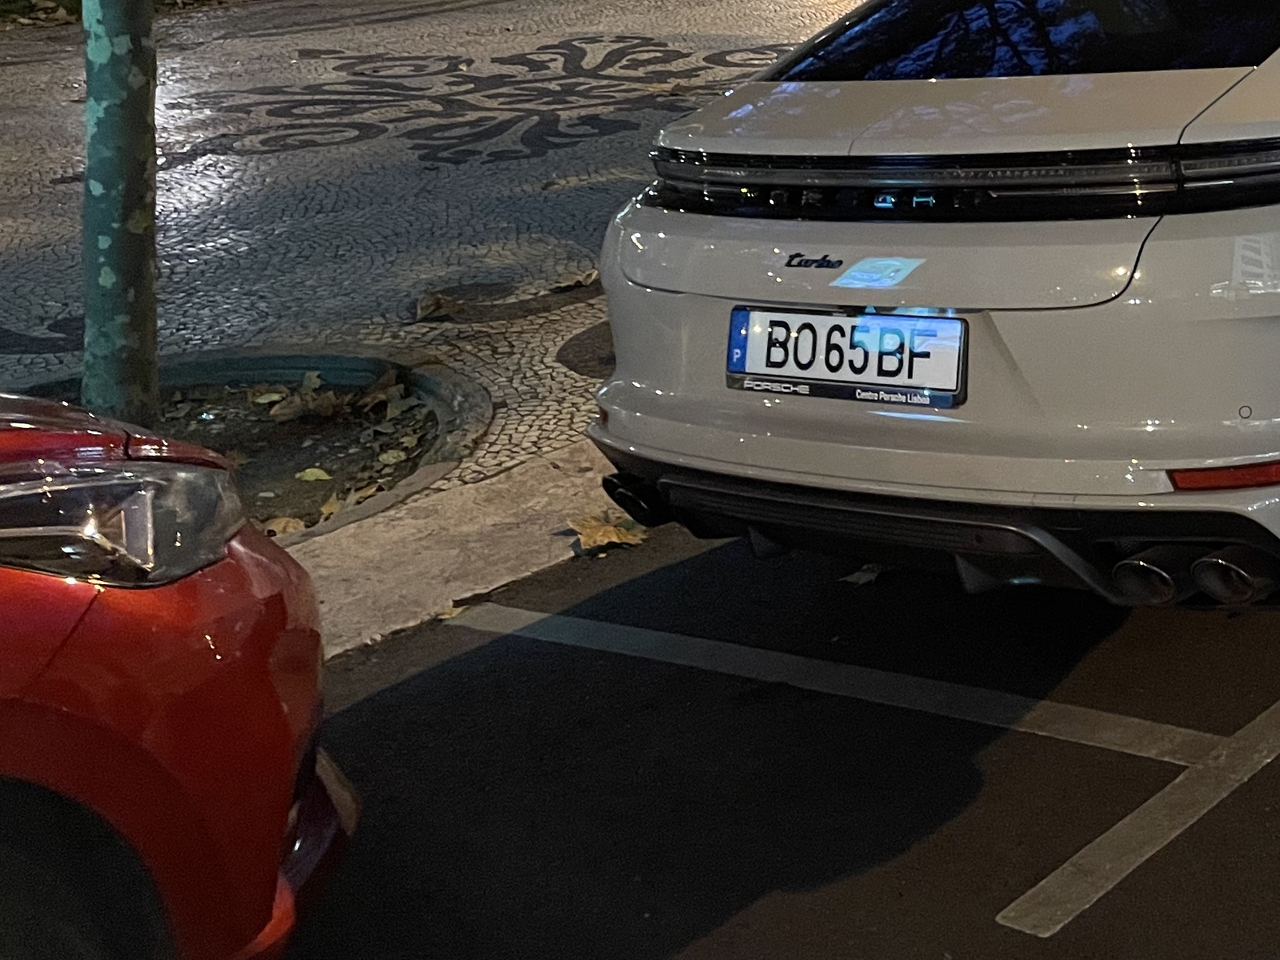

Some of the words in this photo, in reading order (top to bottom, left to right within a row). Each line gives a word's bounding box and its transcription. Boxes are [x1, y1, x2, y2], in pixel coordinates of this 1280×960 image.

[733, 348, 742, 363] P
[743, 380, 811, 395] PORSCHE
[879, 391, 906, 403] Porsche
